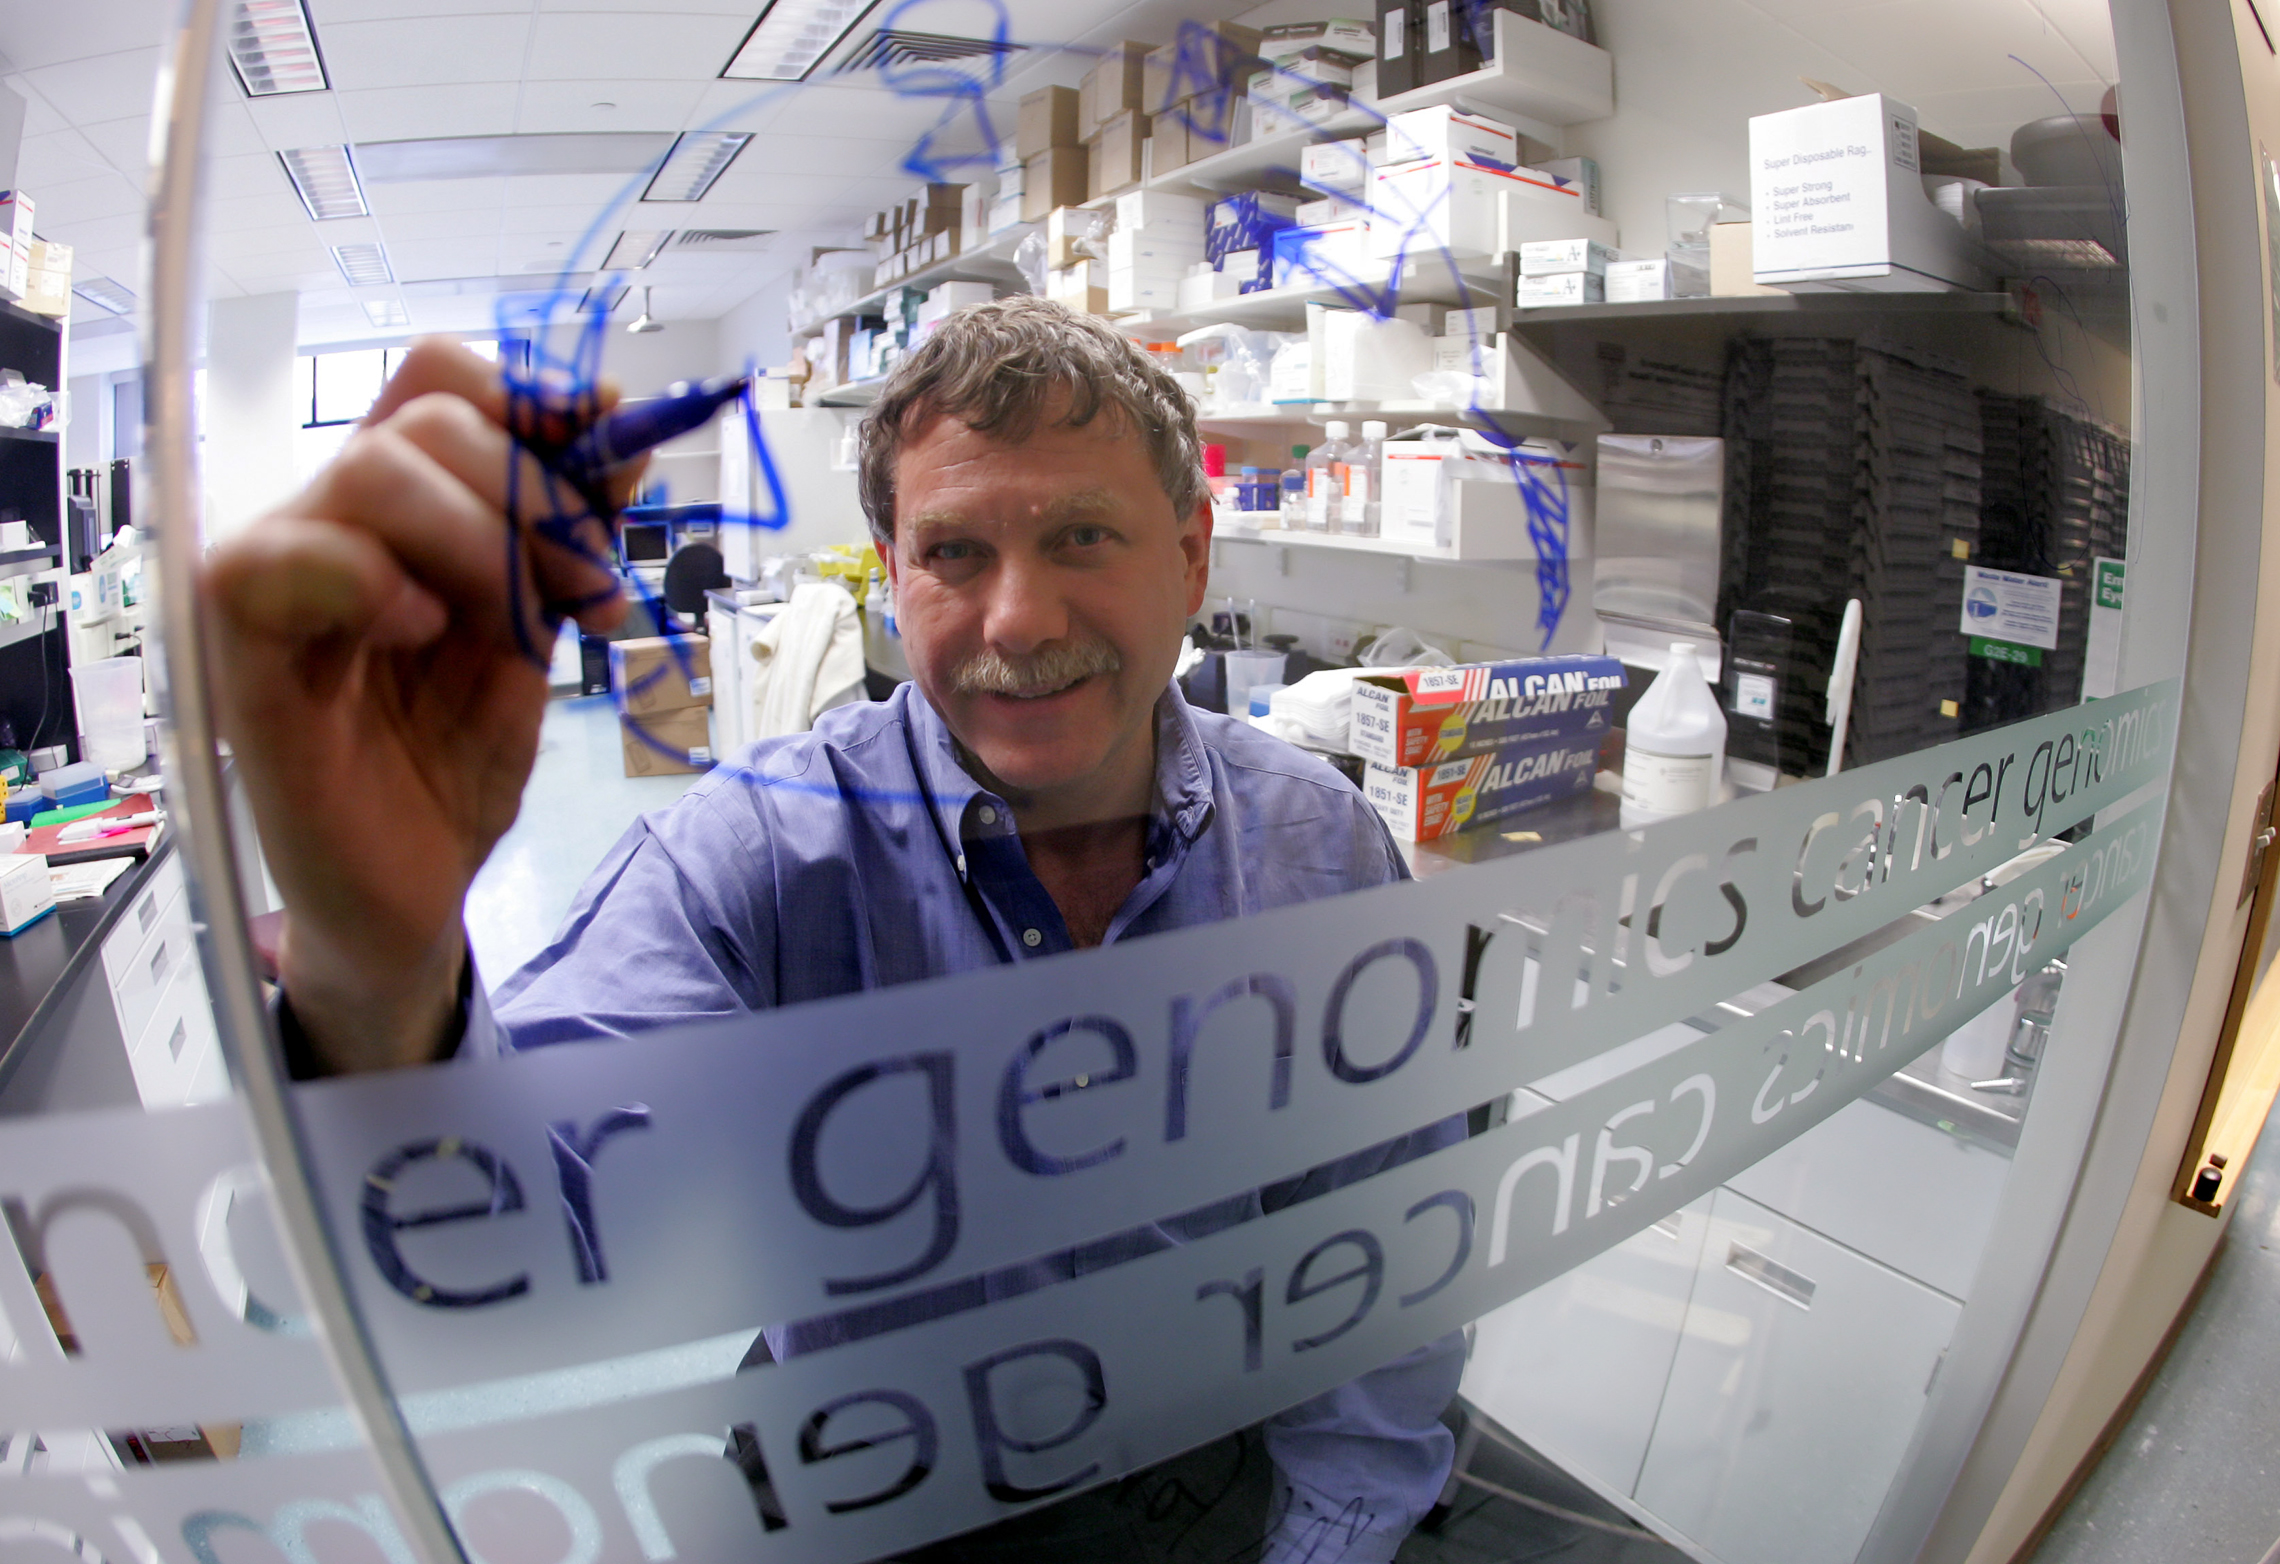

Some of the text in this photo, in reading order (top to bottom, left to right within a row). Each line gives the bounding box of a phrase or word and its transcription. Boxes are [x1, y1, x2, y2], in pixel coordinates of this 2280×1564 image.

[1764, 144, 1872, 170] Super Disposable Rag
[1773, 181, 1833, 197] Super Strong
[1773, 192, 1851, 211] Super Absorbent
[1773, 212, 1814, 225] Lint Free
[1774, 226, 1809, 239] Solvent
[1423, 674, 1460, 688] 1857-SE
[1356, 686, 1389, 703] ALCAN
[1472, 689, 1610, 724] ALCAN FOIL
[1356, 711, 1390, 733] 1857-SE
[1436, 763, 1468, 780] 1851-SE
[1480, 748, 1595, 793] ALCAN FOIL
[1369, 785, 1409, 807] 1851-SE
[0, 687, 2167, 1364] ncer genomics cancer genomics
